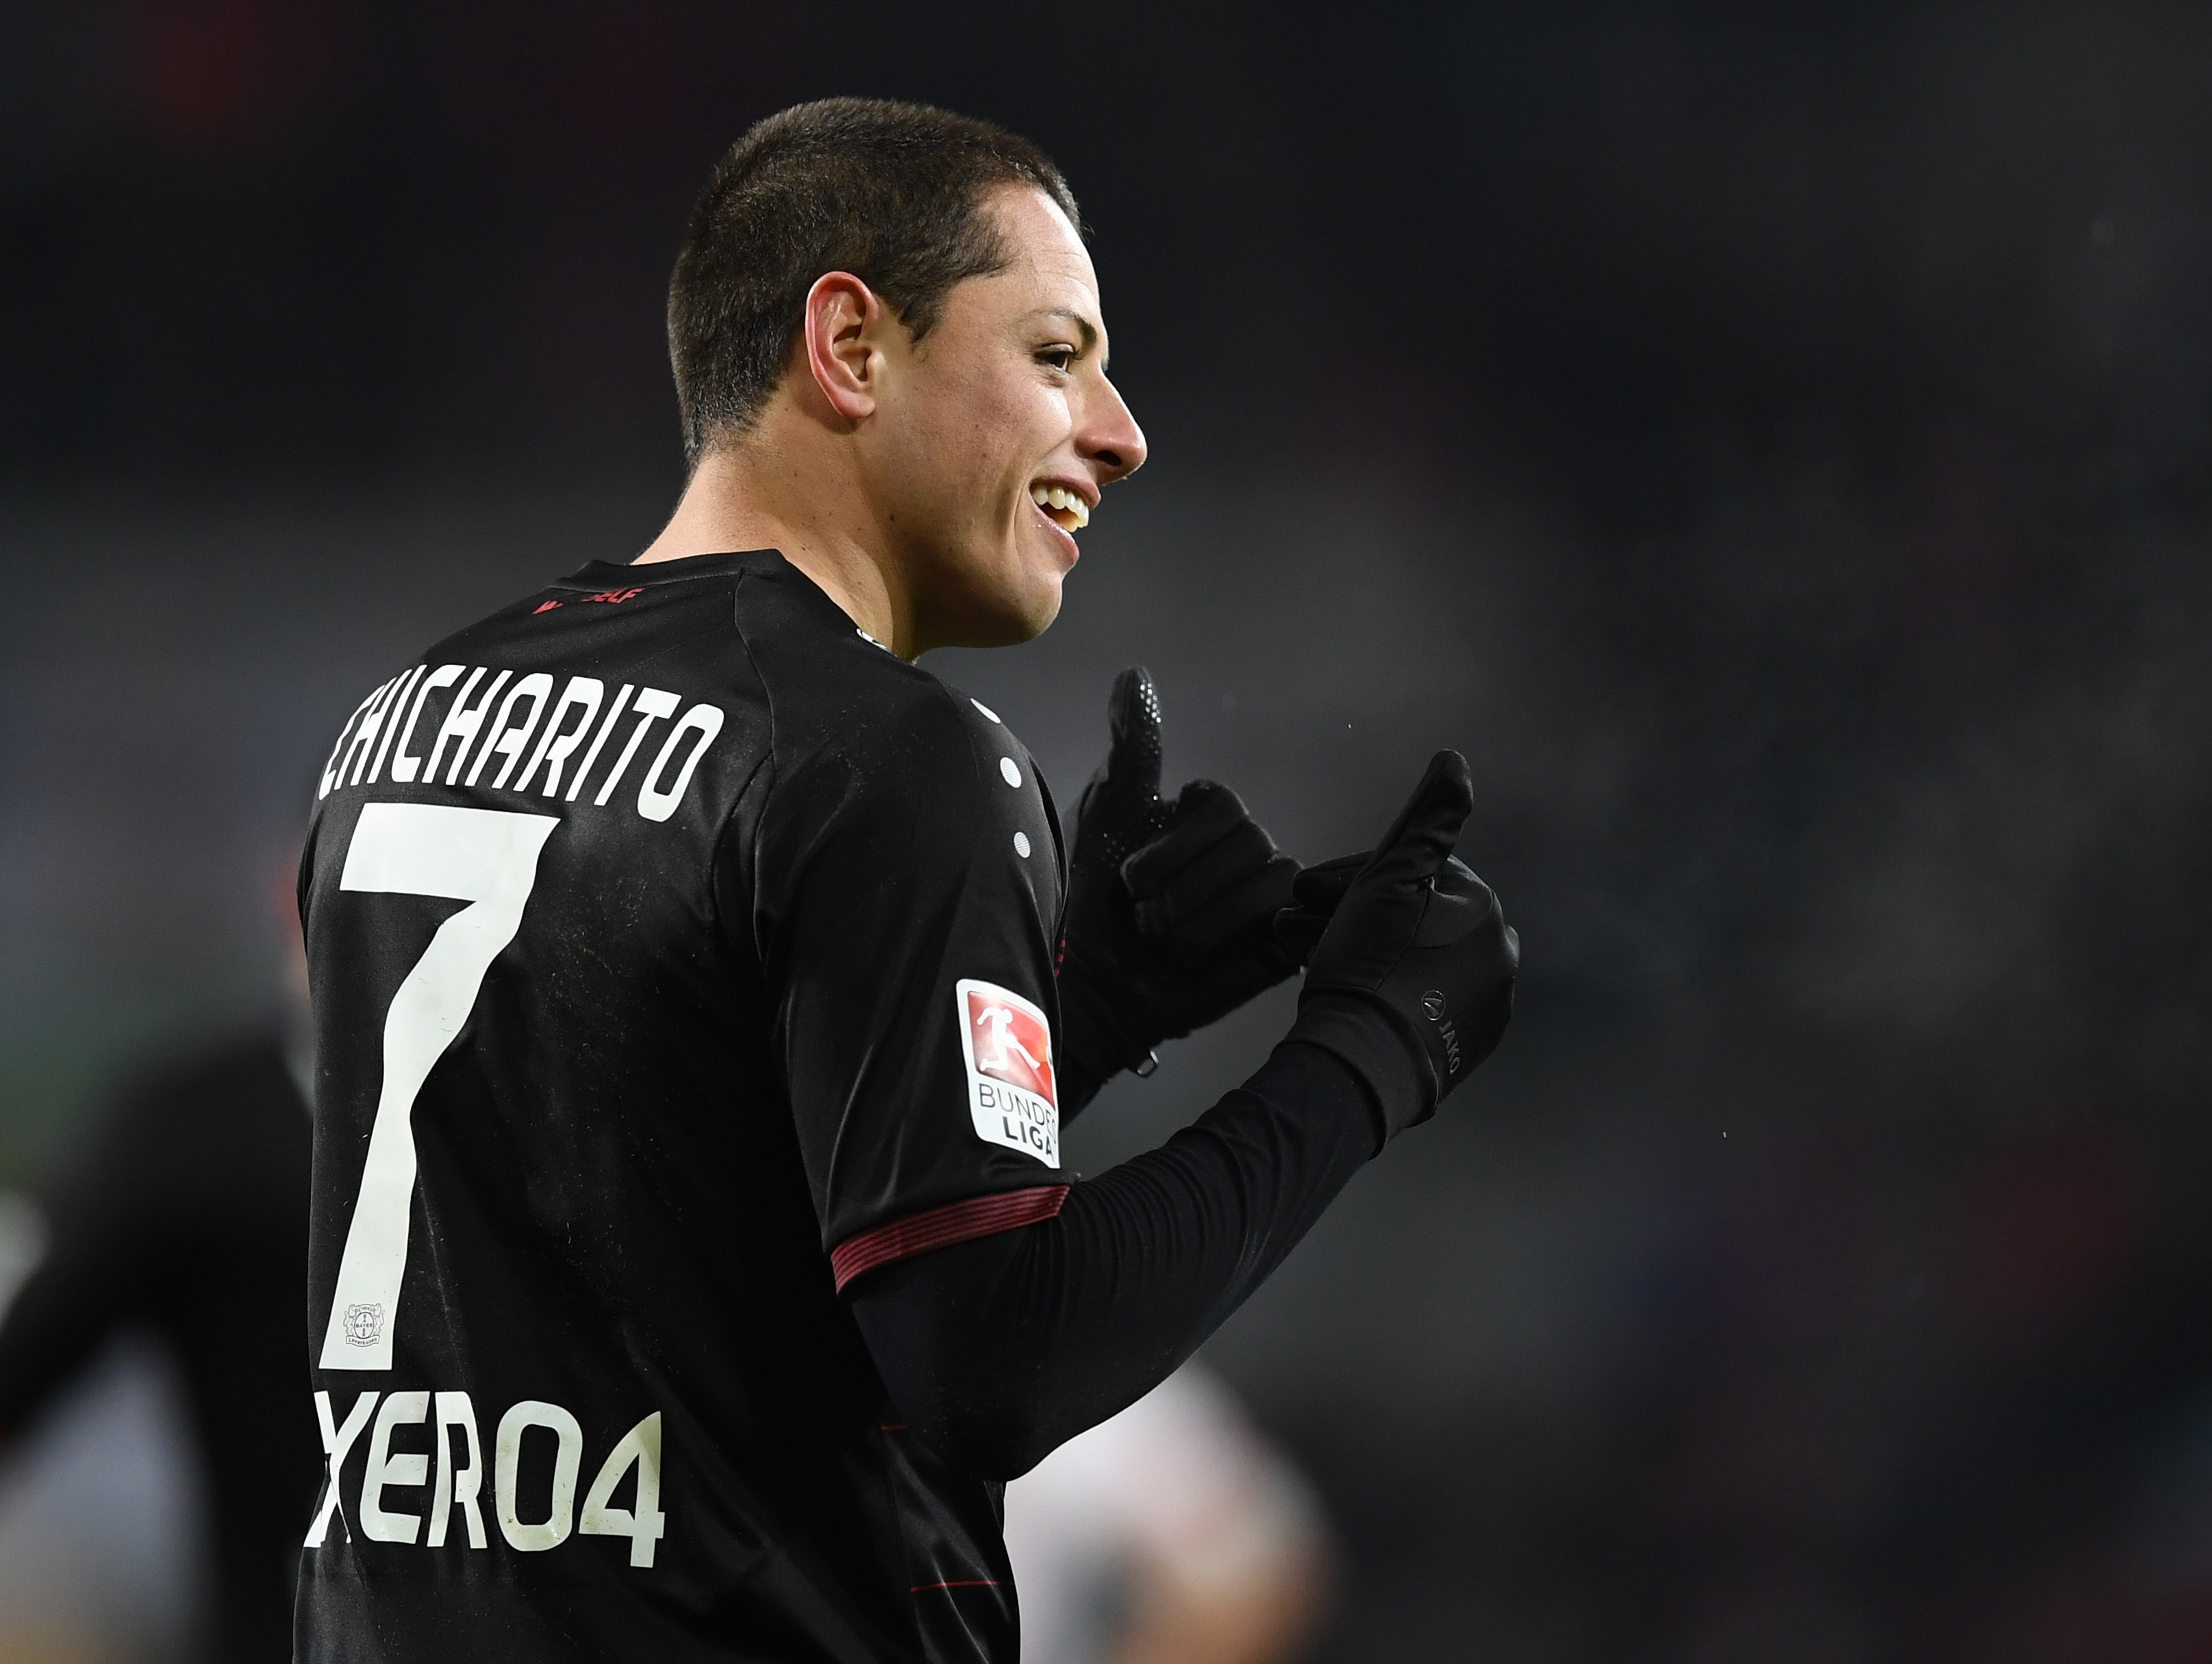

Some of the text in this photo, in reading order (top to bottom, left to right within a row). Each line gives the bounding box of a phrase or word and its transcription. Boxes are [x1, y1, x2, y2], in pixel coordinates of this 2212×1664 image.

[318, 664, 725, 822] CHICHARITO
[318, 803, 560, 1370] 7
[1439, 1020, 1461, 1074] JAKO
[1002, 1115, 1055, 1162] LIGA
